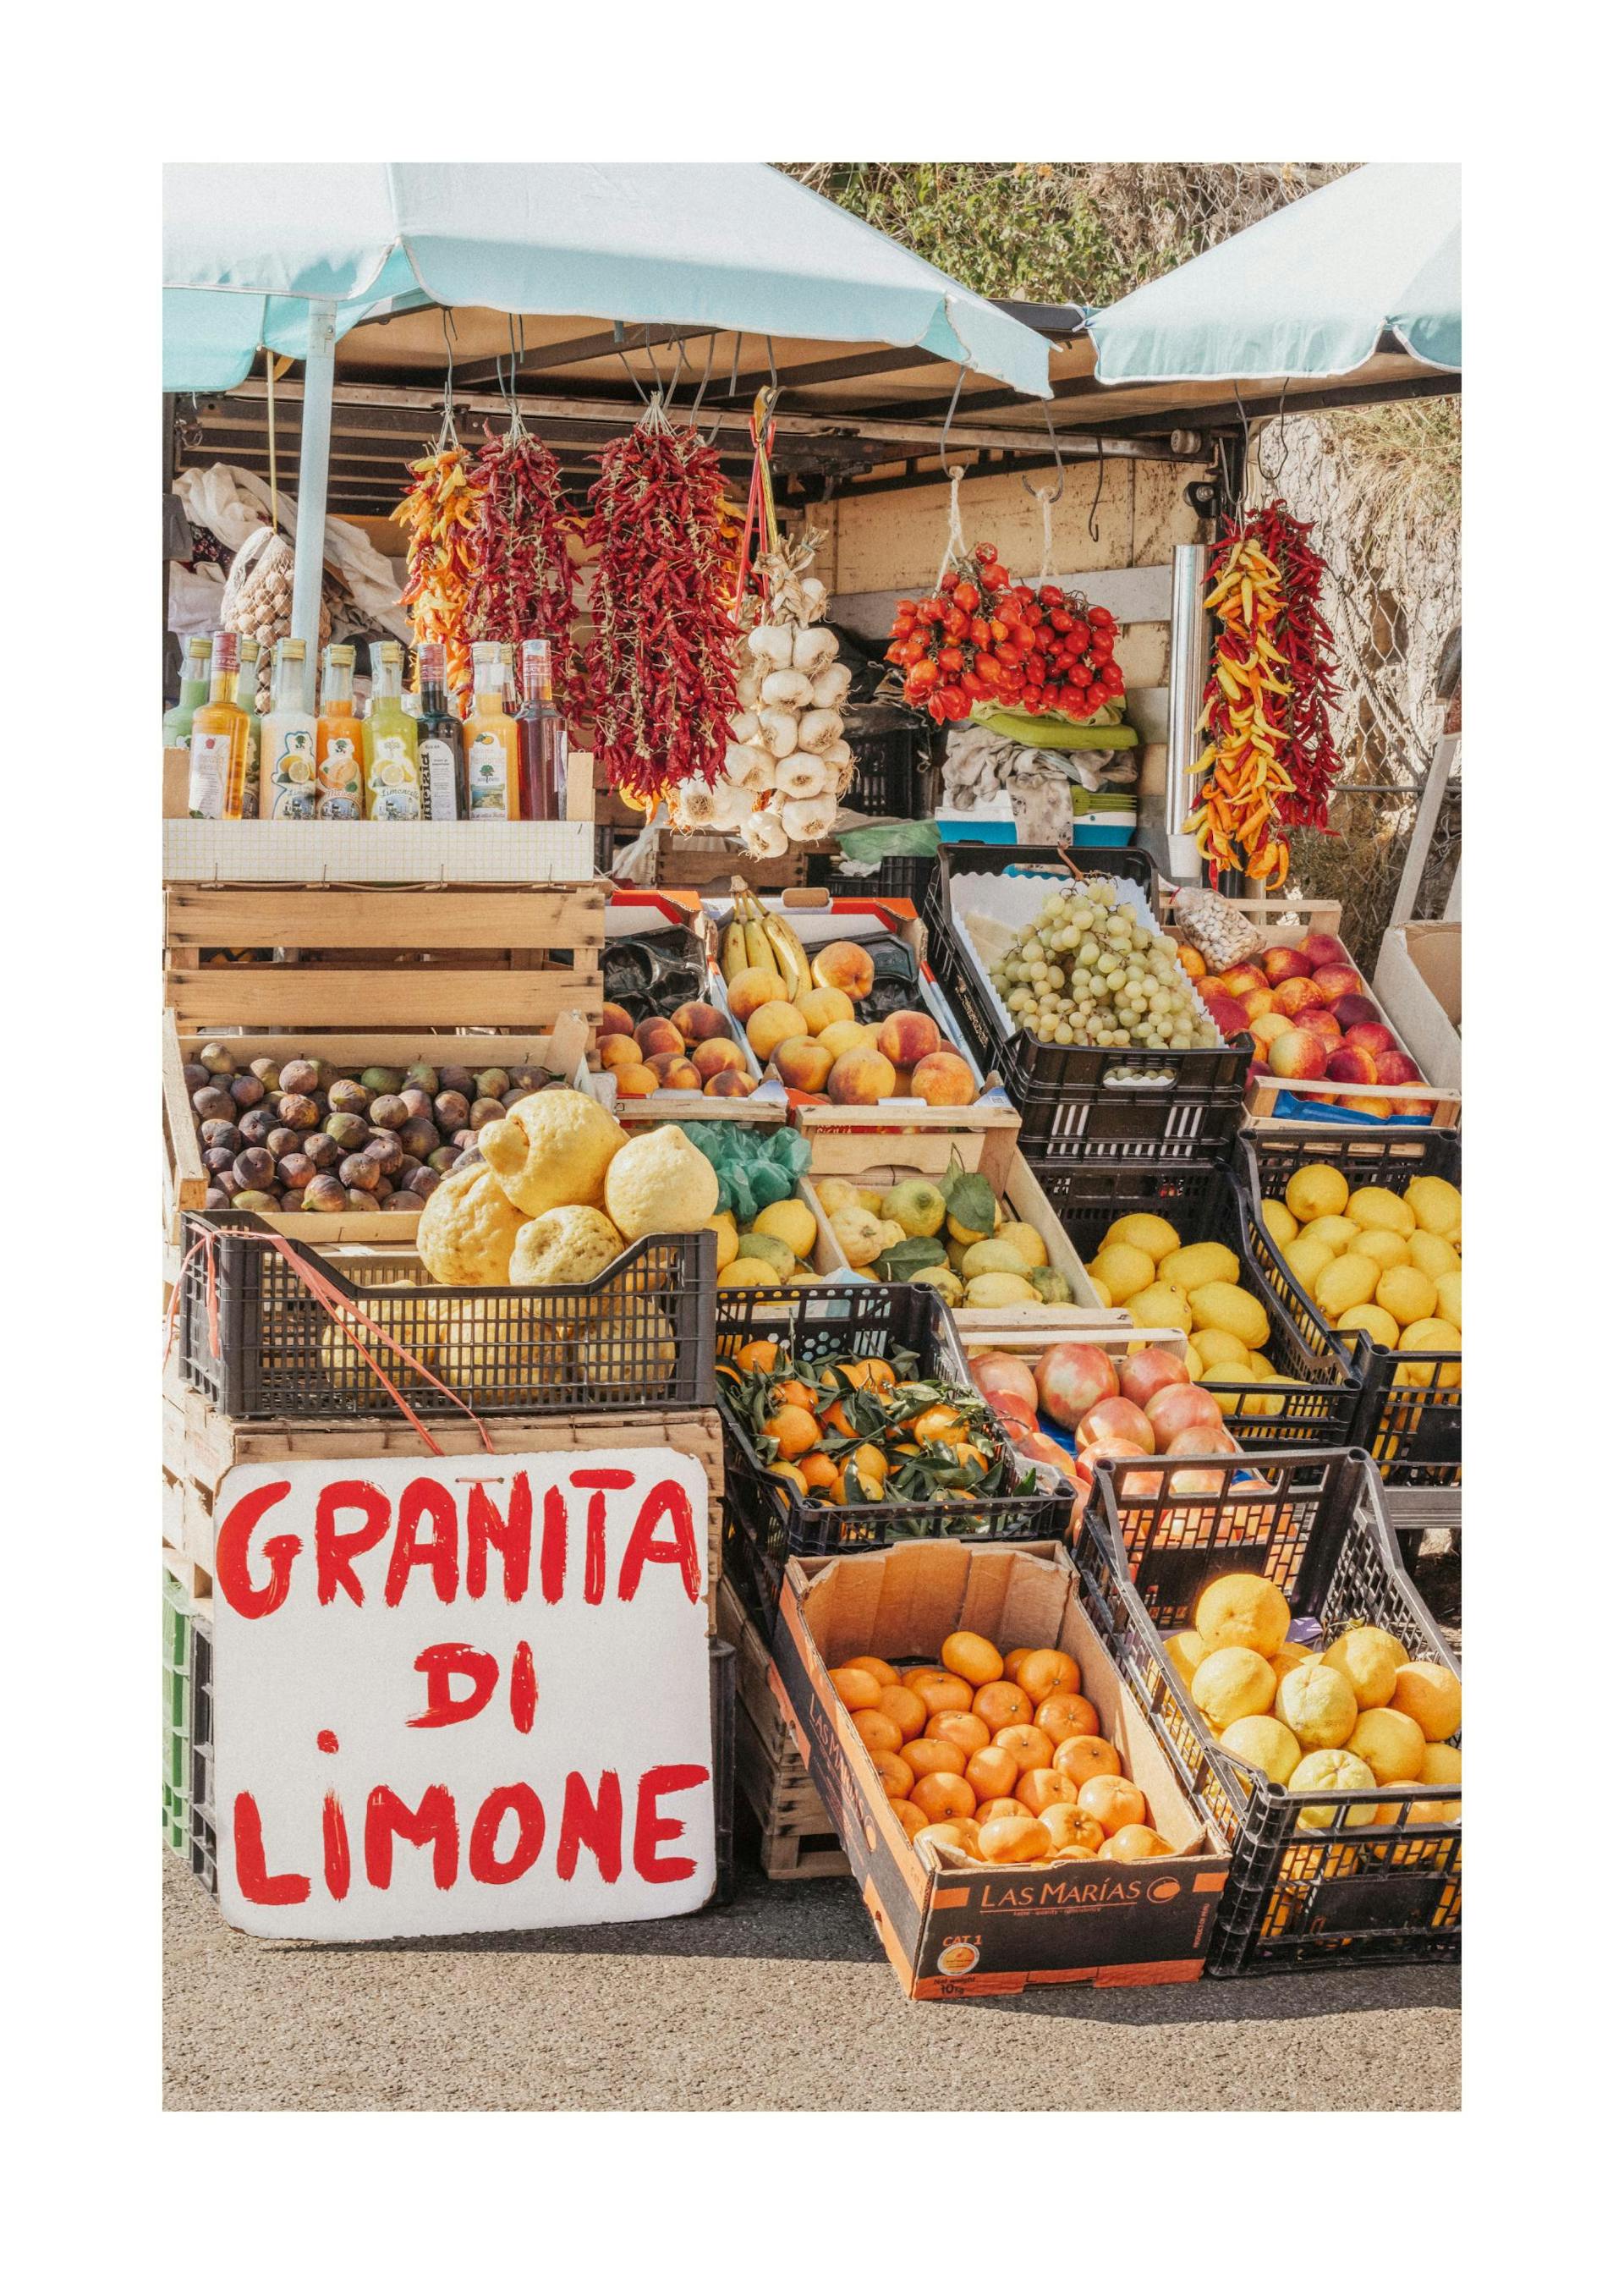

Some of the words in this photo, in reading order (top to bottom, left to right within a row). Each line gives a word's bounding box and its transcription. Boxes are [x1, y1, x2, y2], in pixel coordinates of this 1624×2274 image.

[216, 1469, 701, 1619] GRANITA
[405, 1640, 540, 1734] DI
[809, 1693, 829, 1745] LAS
[980, 1885, 1034, 1907] LAS
[1040, 1876, 1142, 1904] MARÍAS
[942, 1935, 972, 1947] CAT
[974, 1935, 983, 1945] 1
